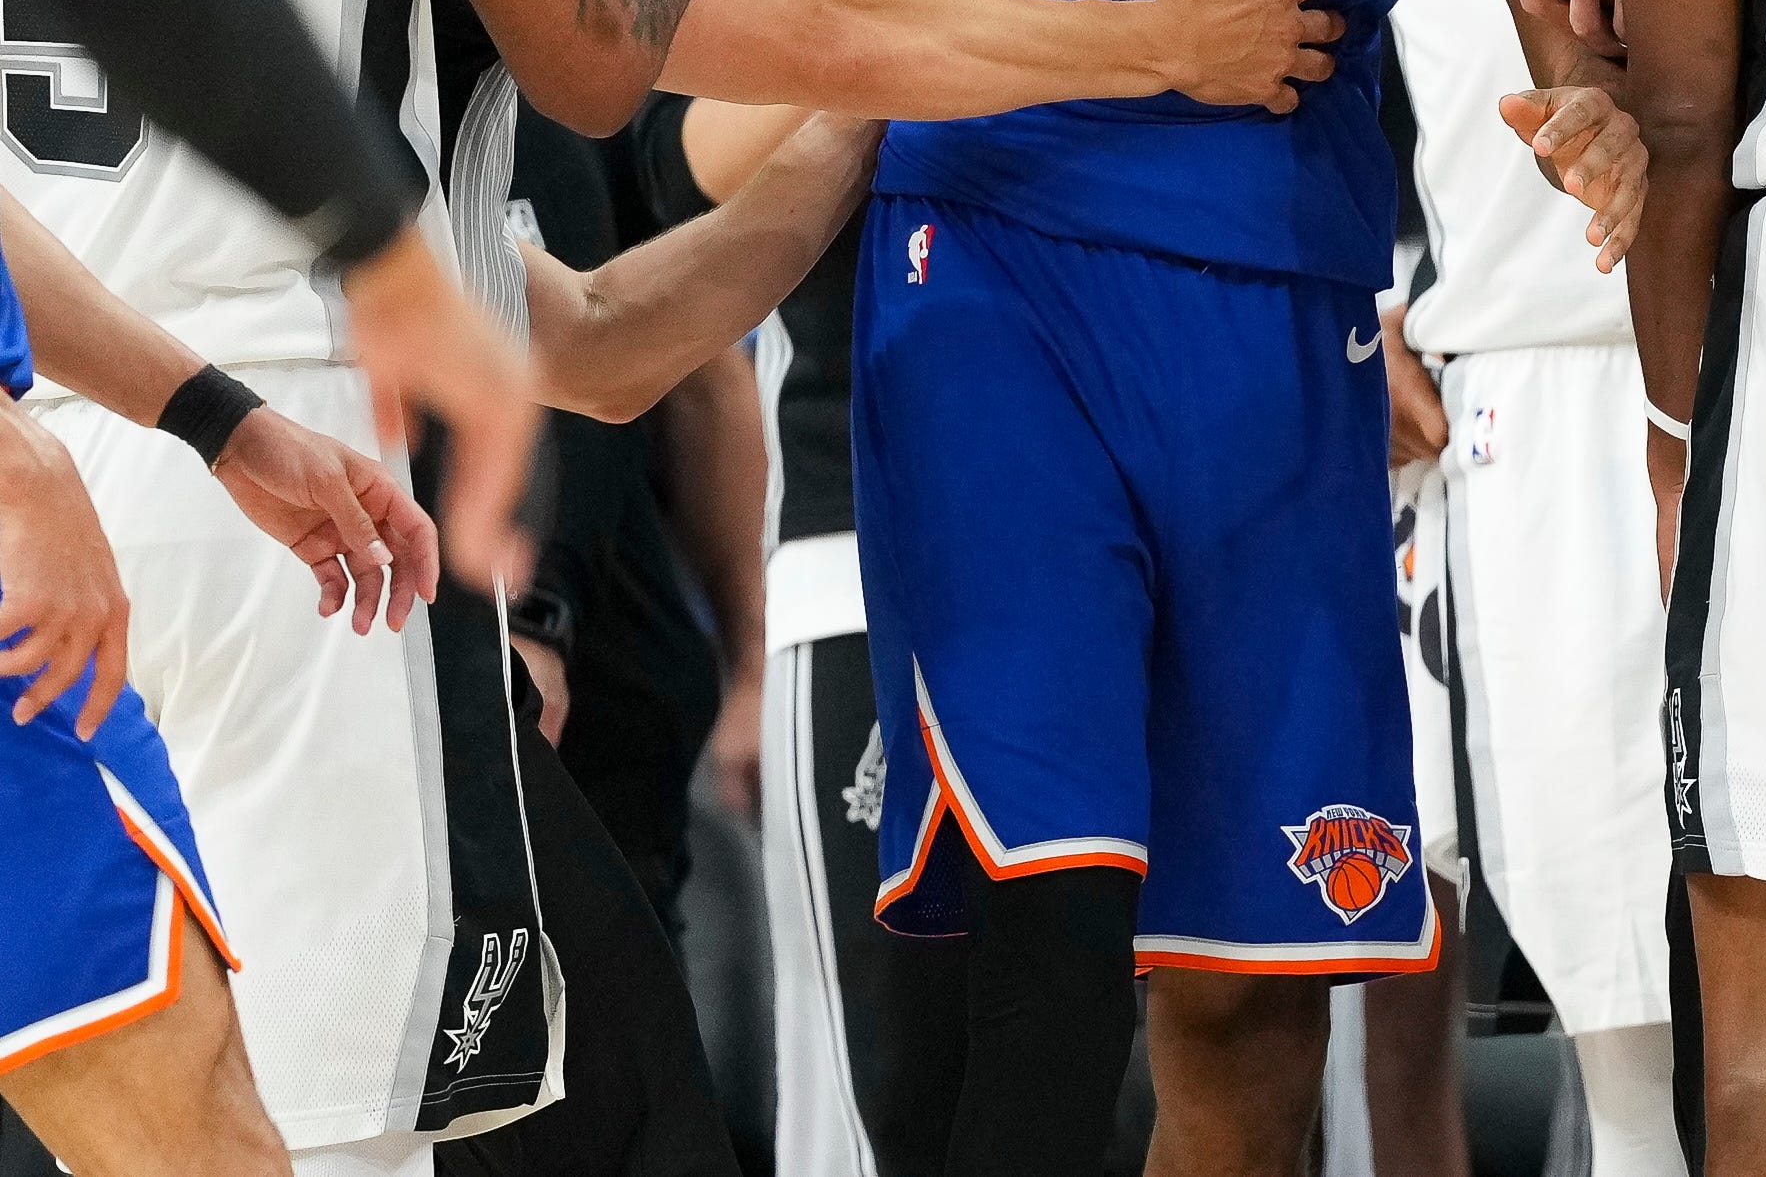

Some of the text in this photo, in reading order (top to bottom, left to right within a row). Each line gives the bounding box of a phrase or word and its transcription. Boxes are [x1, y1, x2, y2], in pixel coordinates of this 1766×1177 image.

[1326, 807, 1369, 820] NEW YORK
[1294, 817, 1409, 868] KNICKS
